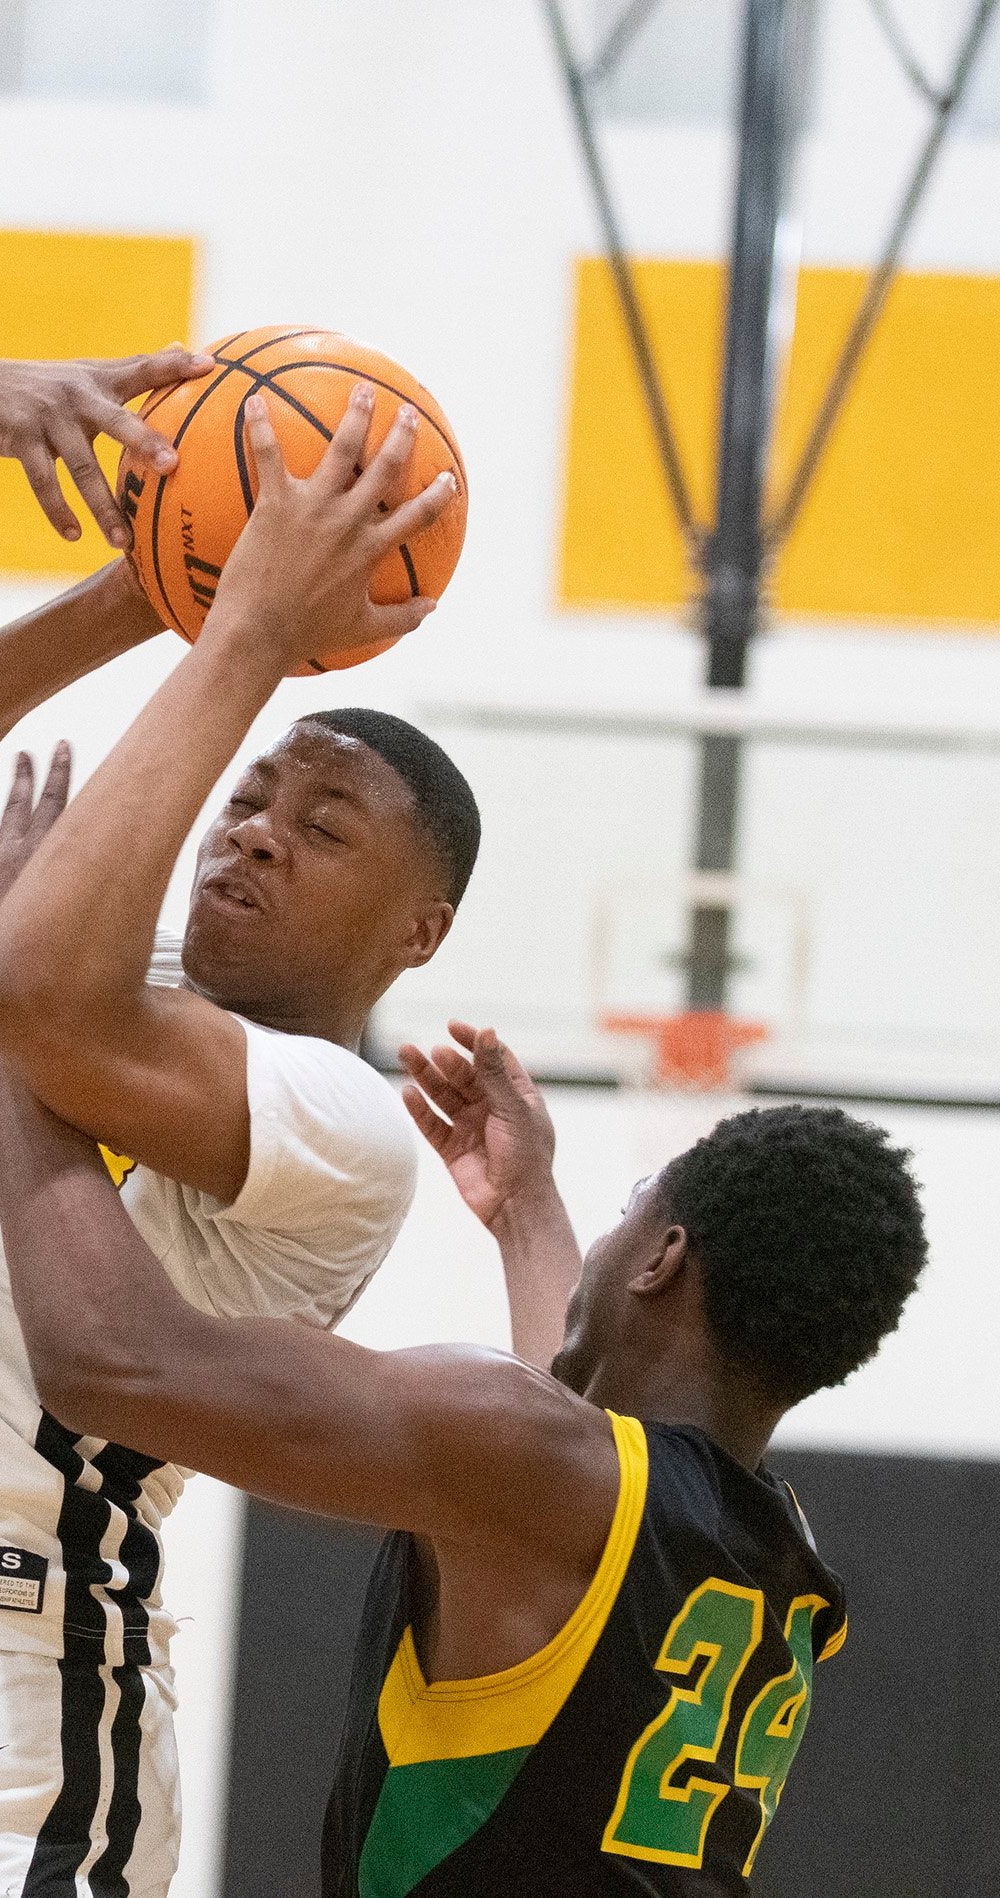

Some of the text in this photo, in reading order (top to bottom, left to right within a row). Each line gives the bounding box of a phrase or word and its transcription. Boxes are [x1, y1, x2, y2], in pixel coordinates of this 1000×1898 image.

[180, 504, 195, 551] NXT
[1, 1552, 21, 1569] S
[601, 1576, 829, 1878] 24
